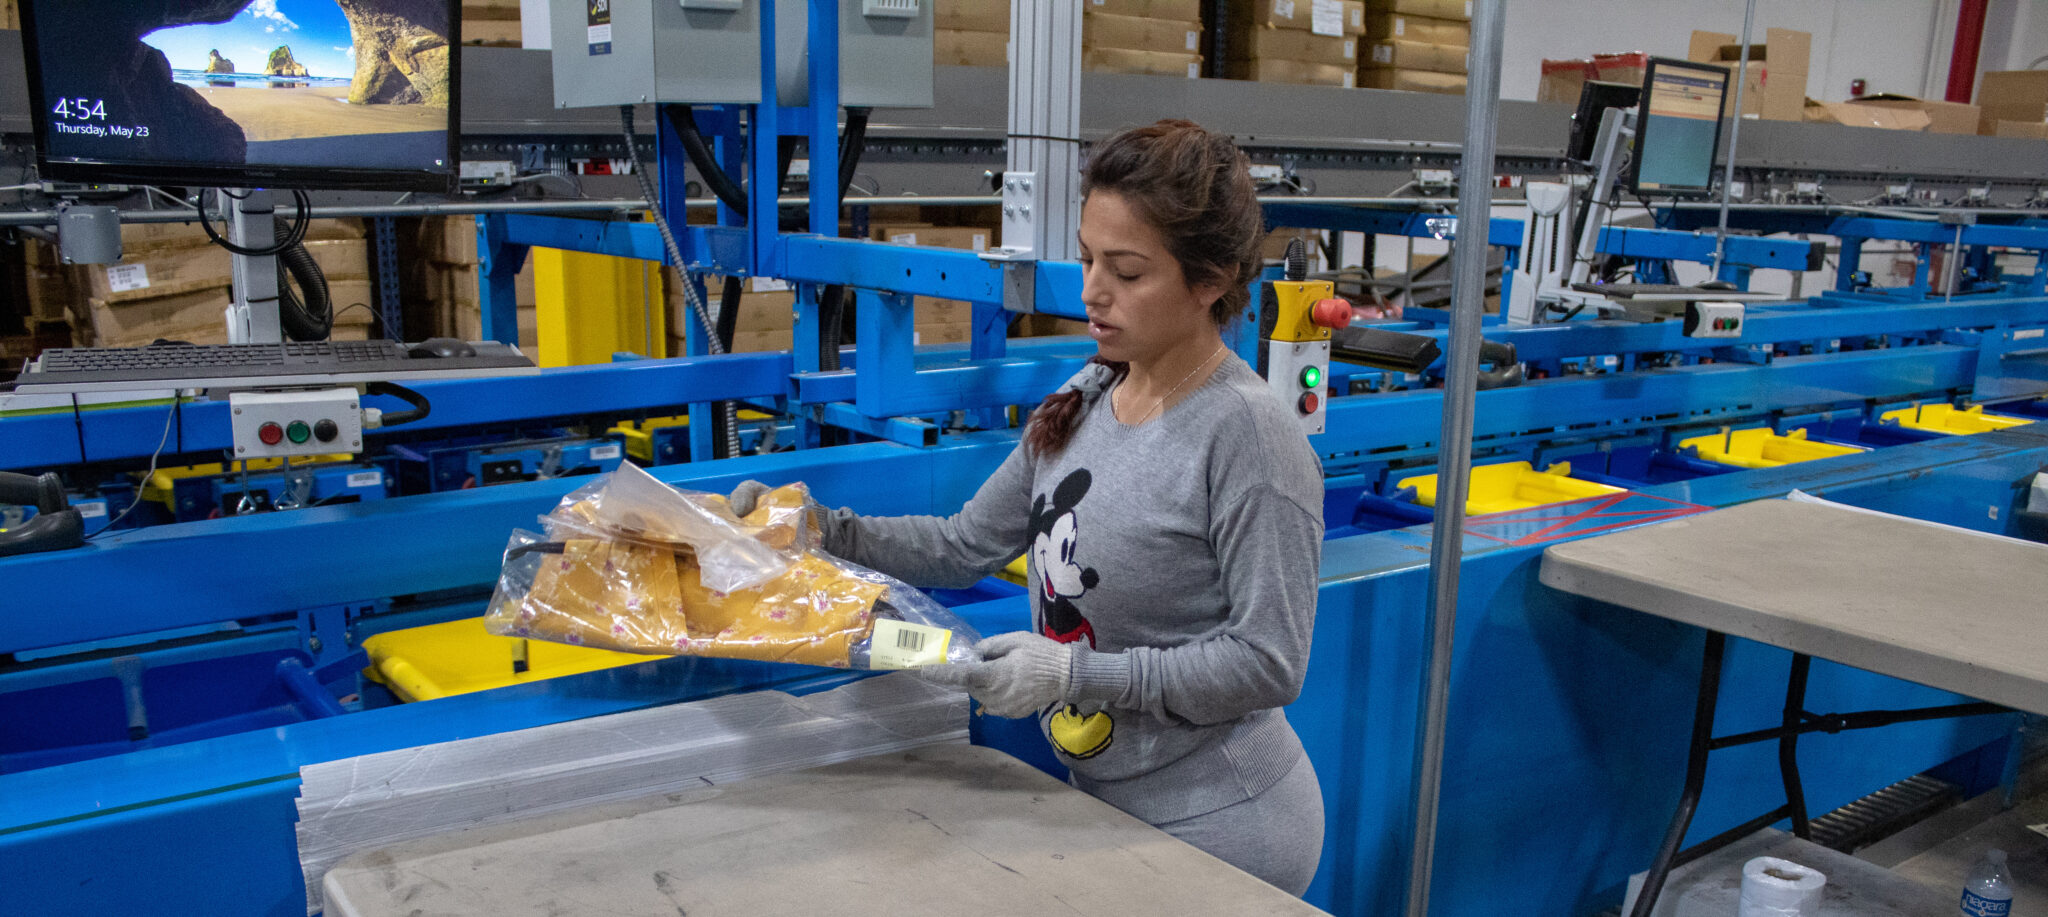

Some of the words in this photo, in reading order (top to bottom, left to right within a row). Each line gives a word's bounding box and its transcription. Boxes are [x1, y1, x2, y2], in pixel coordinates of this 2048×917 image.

[54, 98, 108, 121] 4:54
[56, 122, 108, 138] Thursday,
[110, 125, 134, 138] May
[136, 126, 150, 137] 23
[571, 158, 632, 176] TGW
[1966, 894, 2006, 912] niagara
